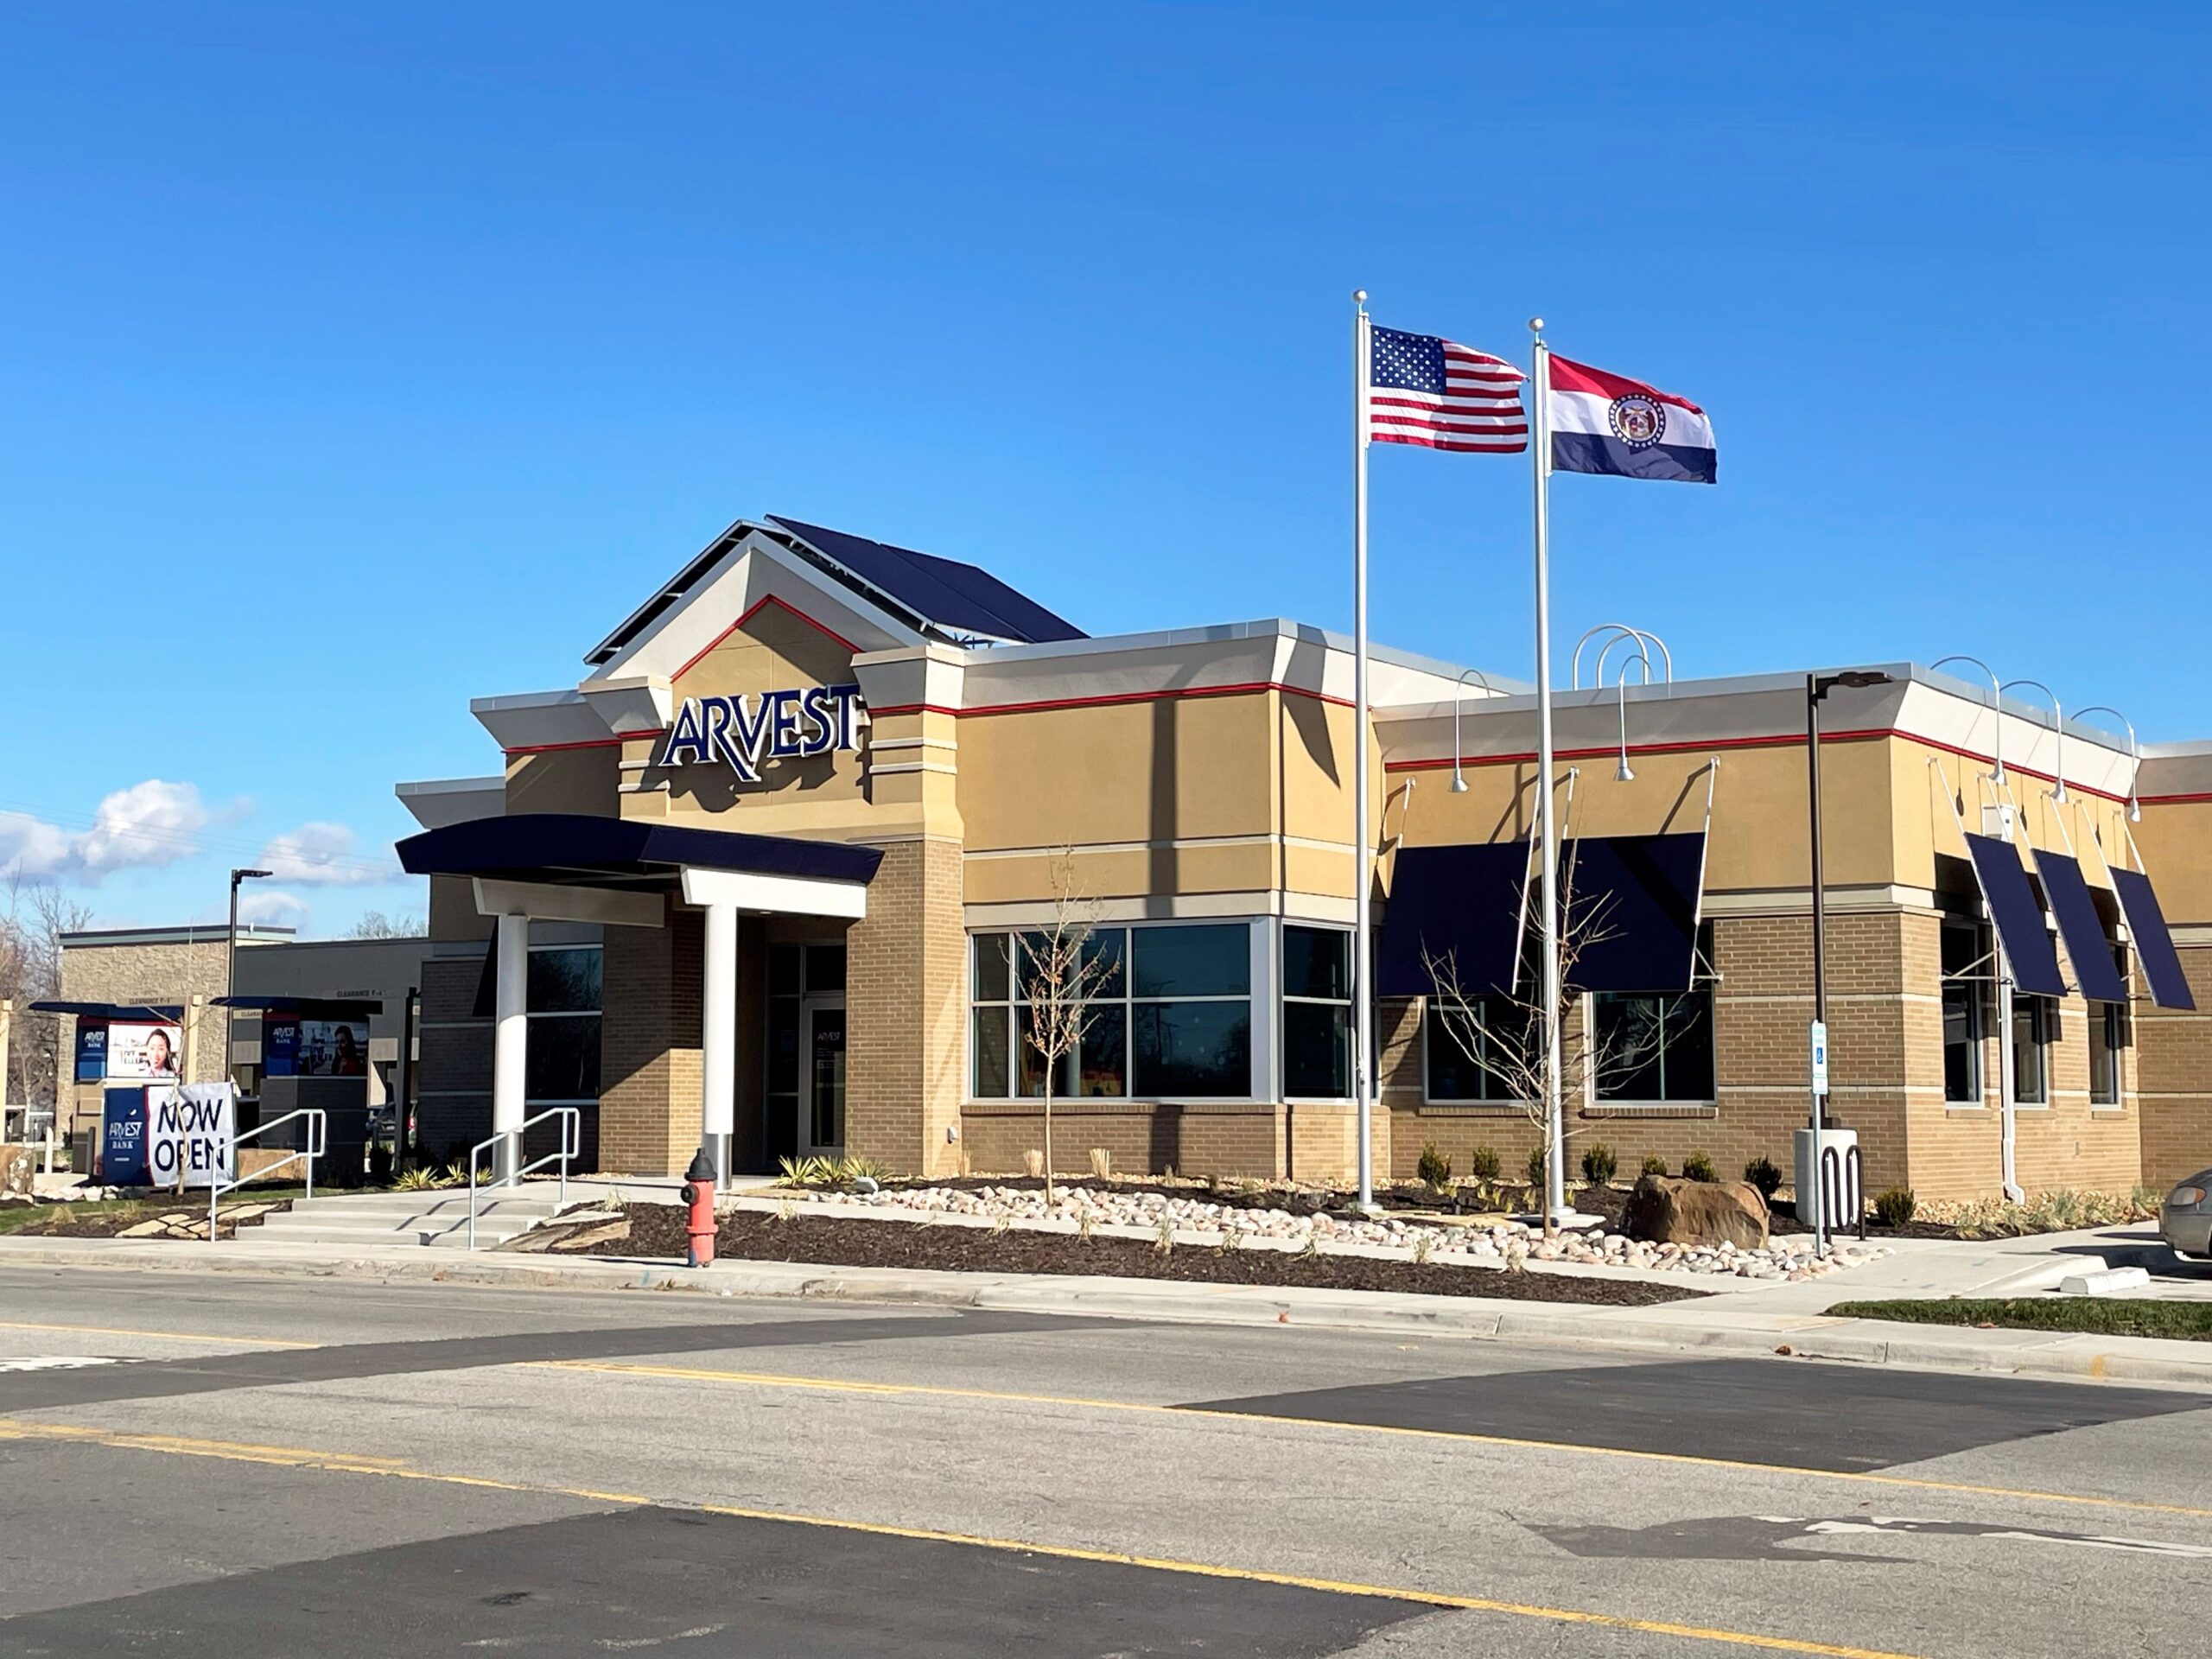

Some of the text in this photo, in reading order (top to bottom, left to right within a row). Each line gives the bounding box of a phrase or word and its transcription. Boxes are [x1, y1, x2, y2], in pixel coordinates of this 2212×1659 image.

[658, 683, 862, 782] ARVEST
[109, 1122, 143, 1141] ARVEST
[157, 1098, 223, 1133] NOW
[112, 1141, 134, 1149] BANK
[155, 1137, 225, 1172] OPEN
